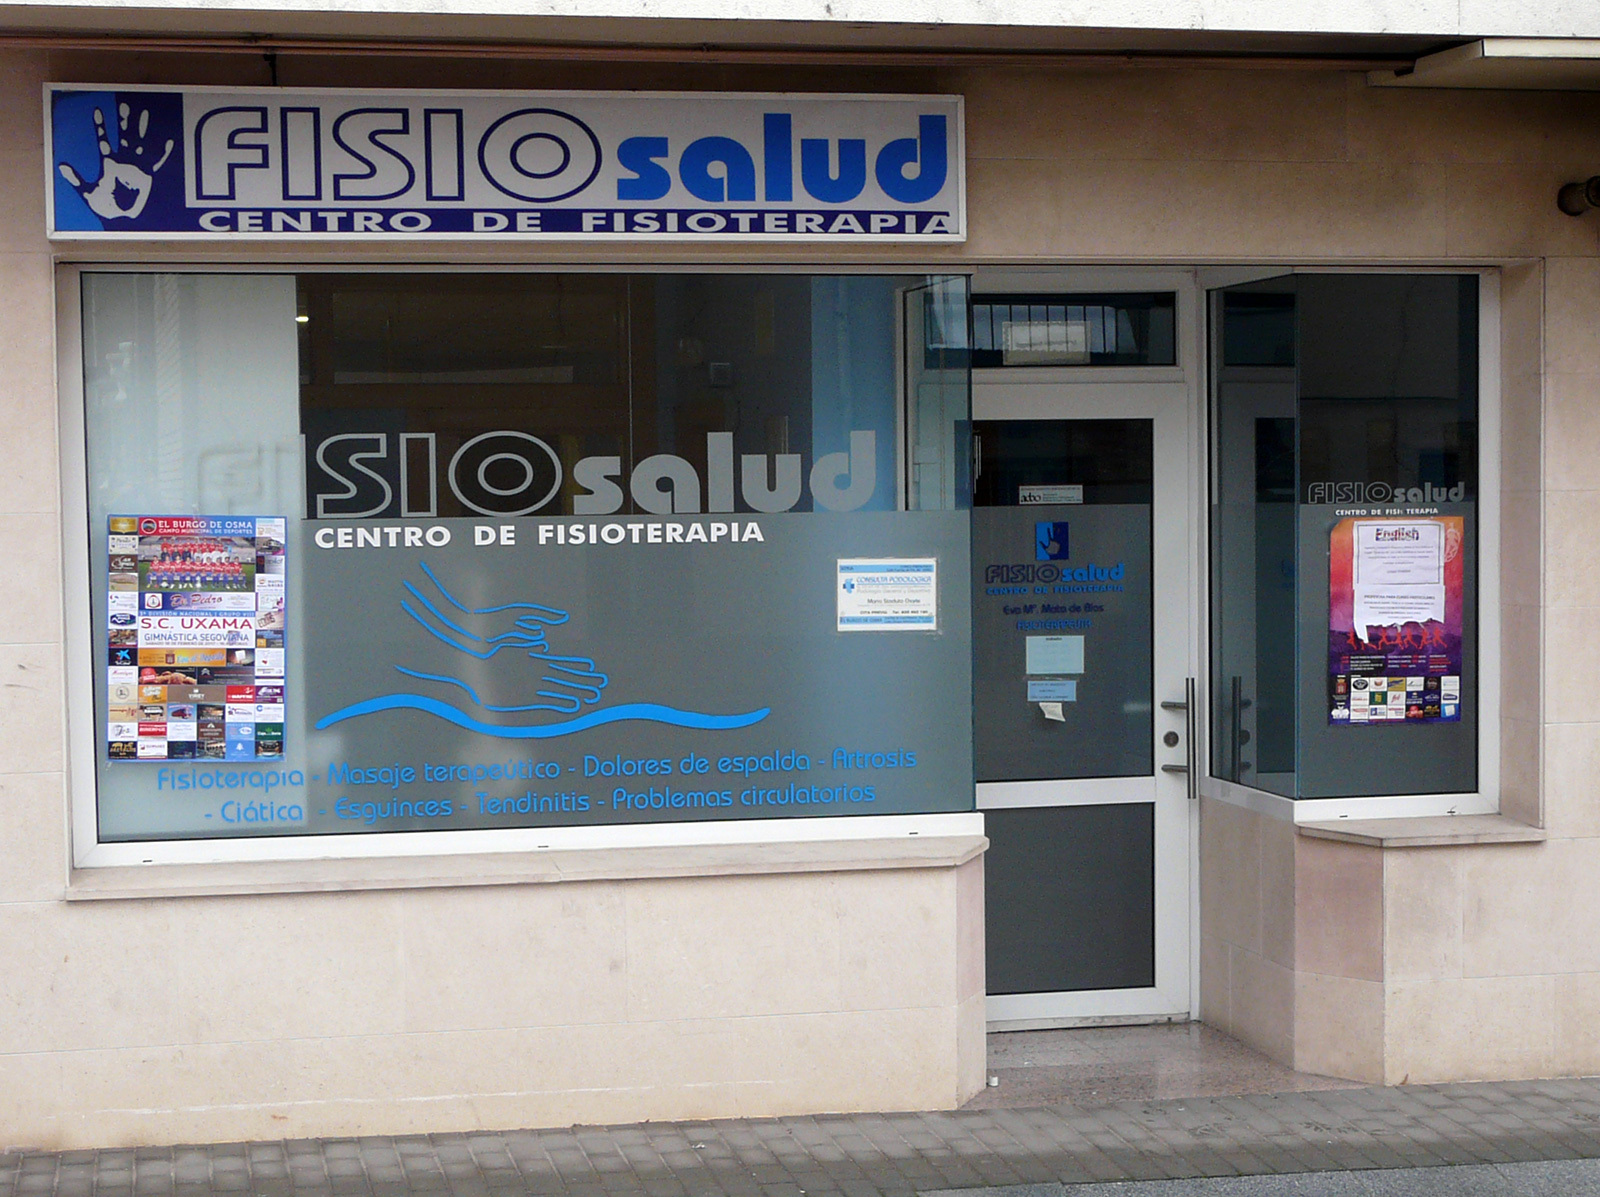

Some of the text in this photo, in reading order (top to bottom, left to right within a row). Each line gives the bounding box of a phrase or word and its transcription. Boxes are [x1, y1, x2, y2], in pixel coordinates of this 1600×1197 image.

[192, 106, 948, 205] FISIOsalud
[199, 210, 953, 234] CENTRO DE FISIOTERAPIA
[1308, 480, 1466, 504] FISIOsalud
[158, 520, 253, 529] EL BURGO DE OSMA
[314, 521, 765, 549] CENTRO DE FISIOTERAPIA
[1375, 527, 1420, 542] English
[856, 576, 888, 584] CONSULTA
[985, 562, 1125, 584] FISIOsalud
[986, 584, 1125, 595] CENTRO DE FISIOTERAPIA
[1003, 605, 1022, 615] Eva
[1069, 602, 1082, 613] de
[140, 617, 174, 630] S.C.
[181, 617, 253, 630] UXAMA
[144, 631, 249, 642] GIMNÁSTICA SEGOVIANA
[158, 767, 304, 792] Fisioterapia
[328, 762, 416, 789] Masaje
[583, 755, 672, 778] Dolores
[679, 752, 711, 774] de
[719, 748, 811, 778] espalda
[832, 746, 918, 770] Artrosis
[221, 800, 304, 823] Ciática
[334, 796, 453, 824] Esguinces
[478, 789, 591, 815] Tendinitis
[612, 786, 733, 810] Problemas
[741, 783, 876, 807] circulatorios
